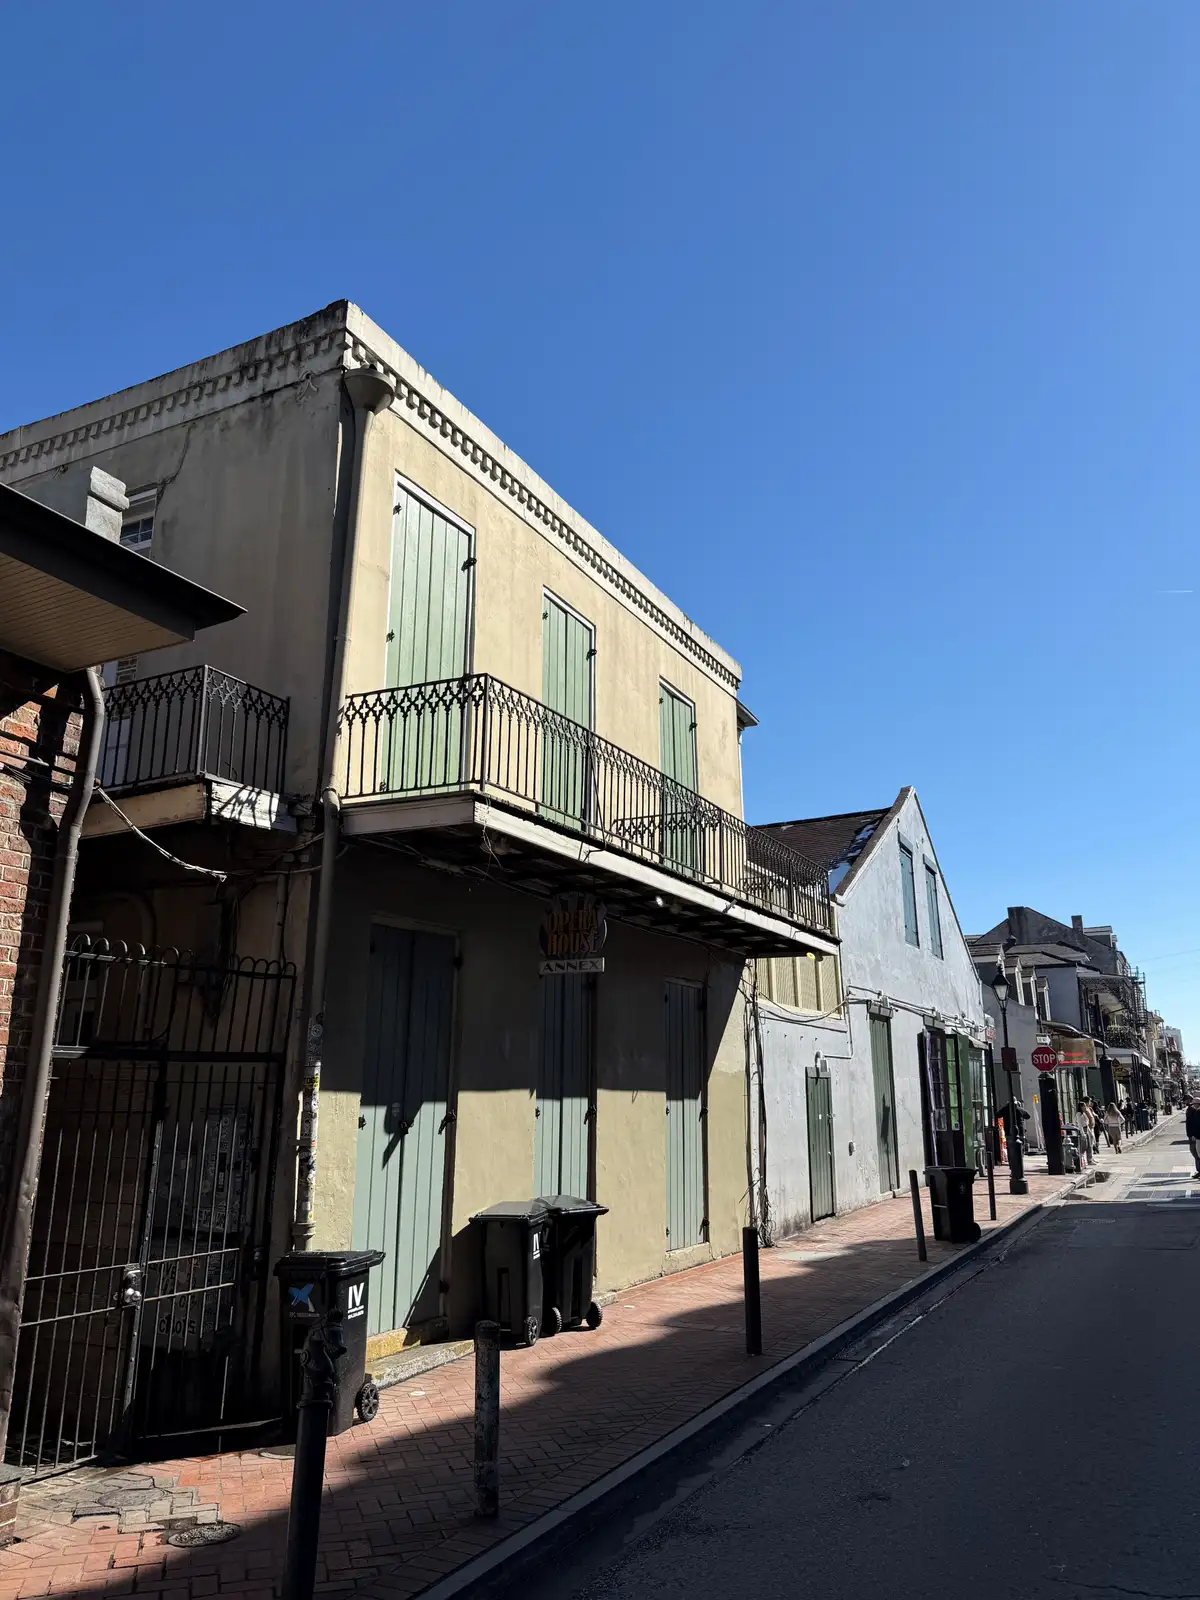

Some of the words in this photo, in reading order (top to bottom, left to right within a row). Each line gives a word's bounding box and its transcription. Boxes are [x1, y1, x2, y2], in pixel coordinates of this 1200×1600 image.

[547, 907, 598, 934] OPERA
[547, 930, 599, 956] HOUSE
[542, 960, 600, 972] ANNEX
[1033, 1053, 1056, 1064] STOP
[347, 1282, 365, 1309] IV
